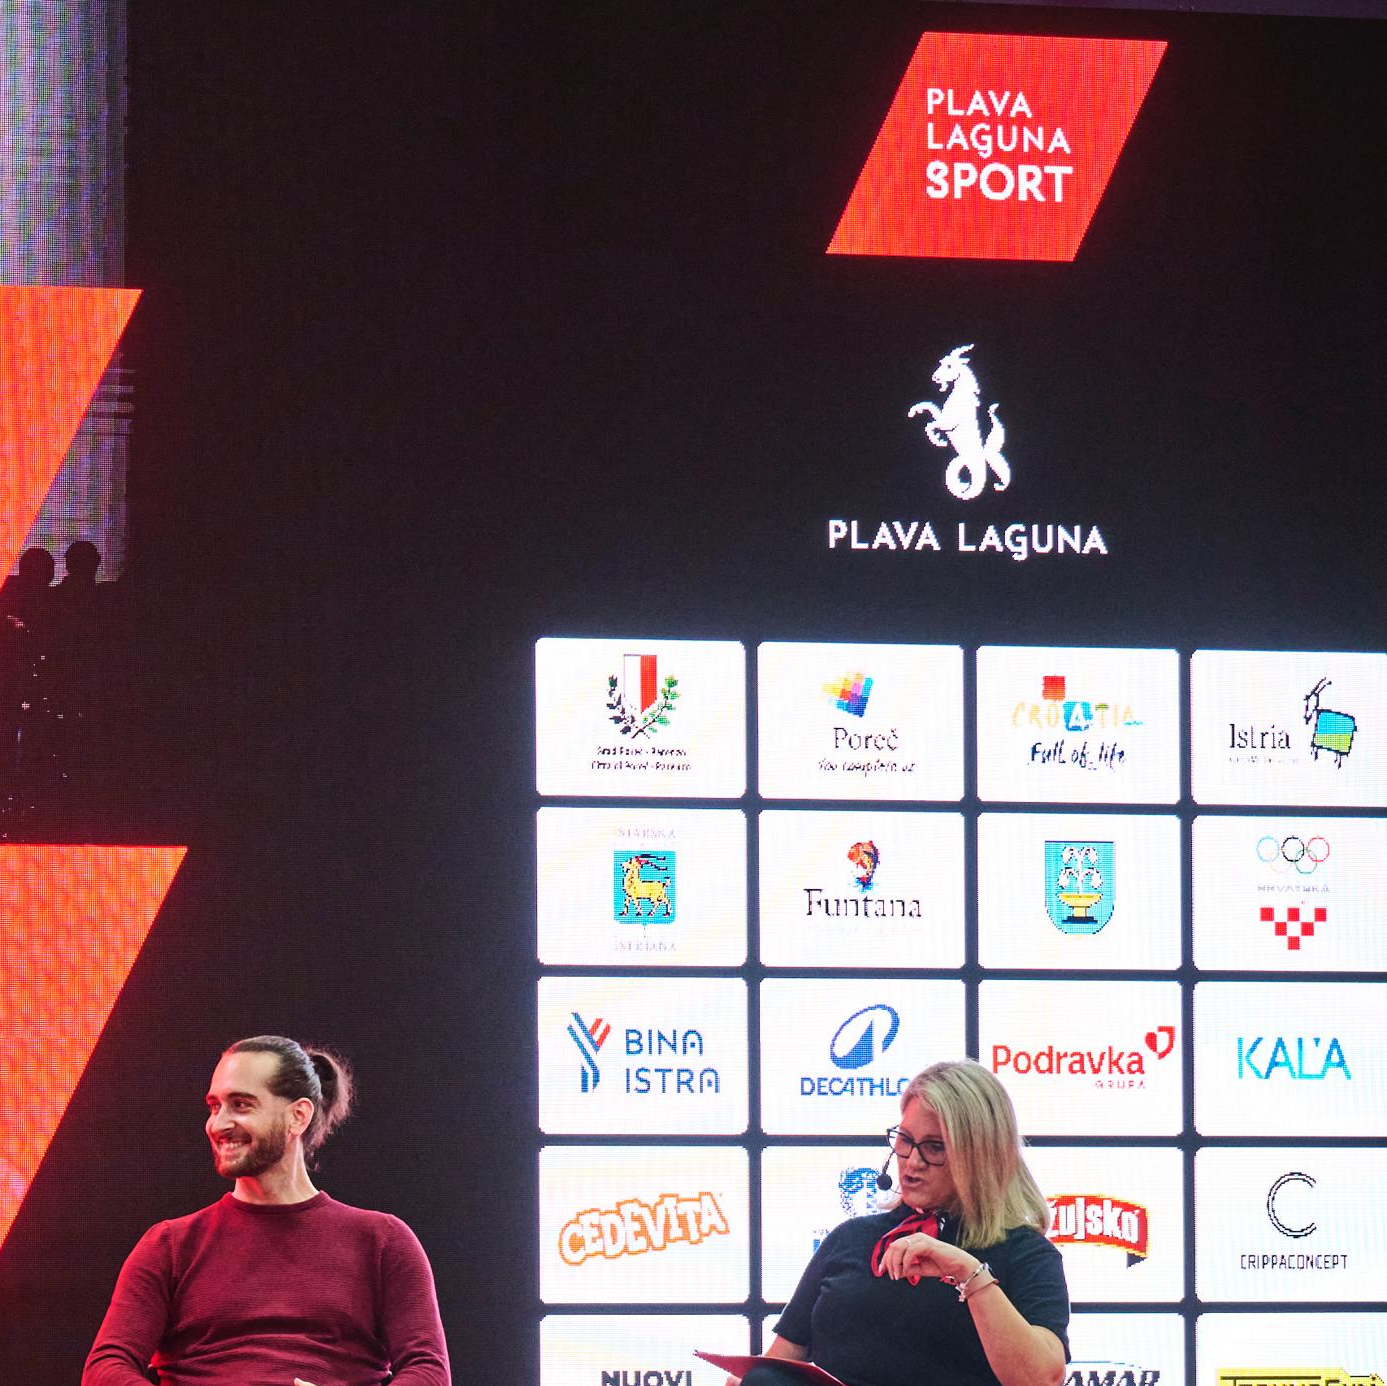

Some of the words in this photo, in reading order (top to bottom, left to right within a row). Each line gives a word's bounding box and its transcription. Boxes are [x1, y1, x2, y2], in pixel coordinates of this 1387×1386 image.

[925, 87, 1032, 119] PLAVA
[925, 123, 1072, 160] LAGUNA
[924, 160, 1073, 205] SPORT
[827, 518, 941, 553] PLAVA
[957, 522, 1109, 562] LAGUNA
[1012, 701, 1144, 731] CROATIA
[1229, 723, 1291, 749] Istria
[803, 888, 923, 918] Funtana
[626, 1028, 704, 1056] BINA
[991, 1043, 1145, 1075] Podravka
[626, 1067, 721, 1094] ISTRA
[558, 1191, 730, 1266] CEDEVITA
